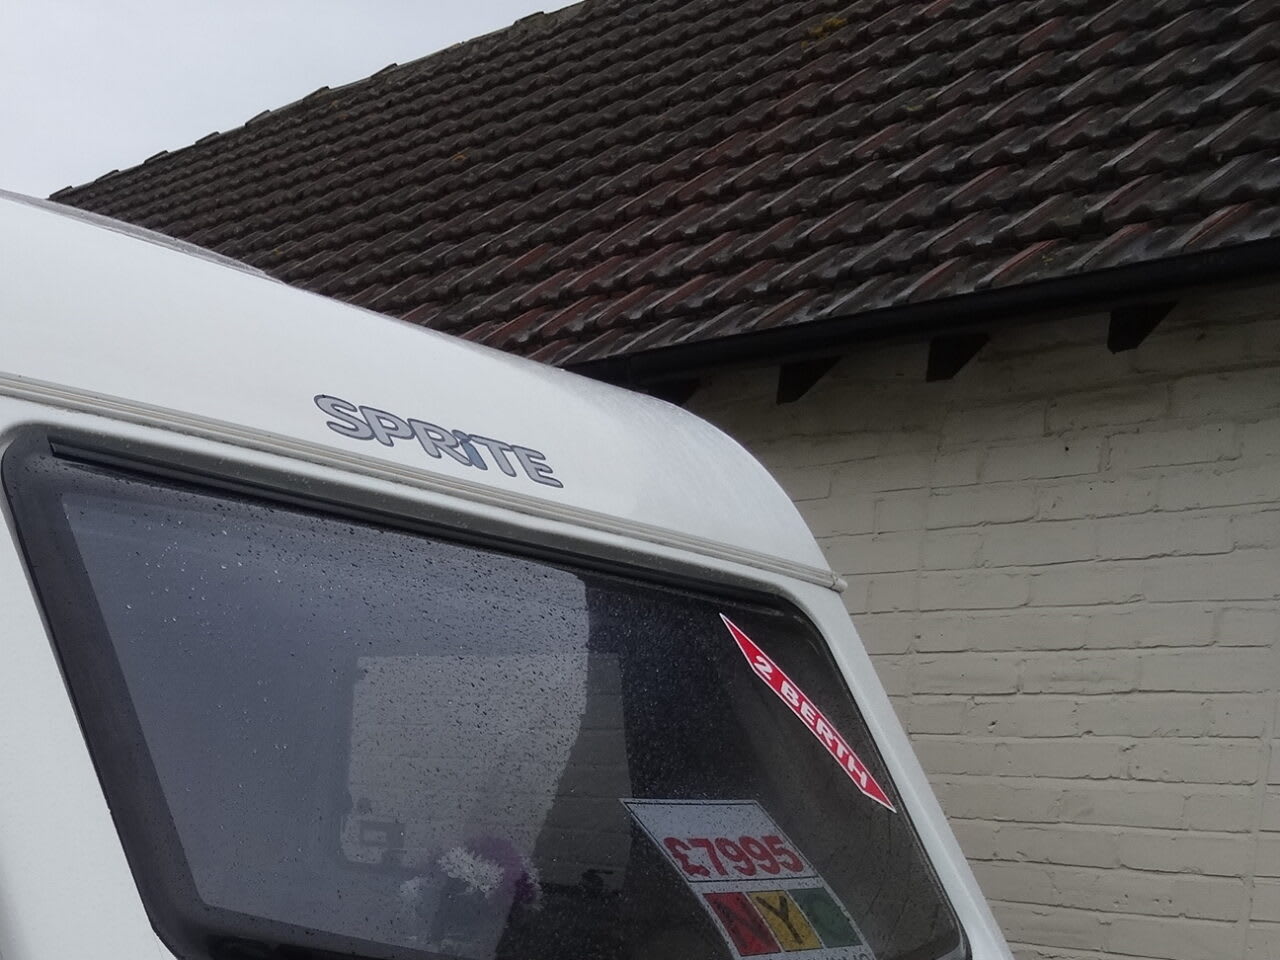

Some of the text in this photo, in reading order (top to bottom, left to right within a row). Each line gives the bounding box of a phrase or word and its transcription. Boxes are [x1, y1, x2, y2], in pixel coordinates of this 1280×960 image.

[753, 655, 868, 789] 2 BERTH
[663, 834, 804, 877] £7995
